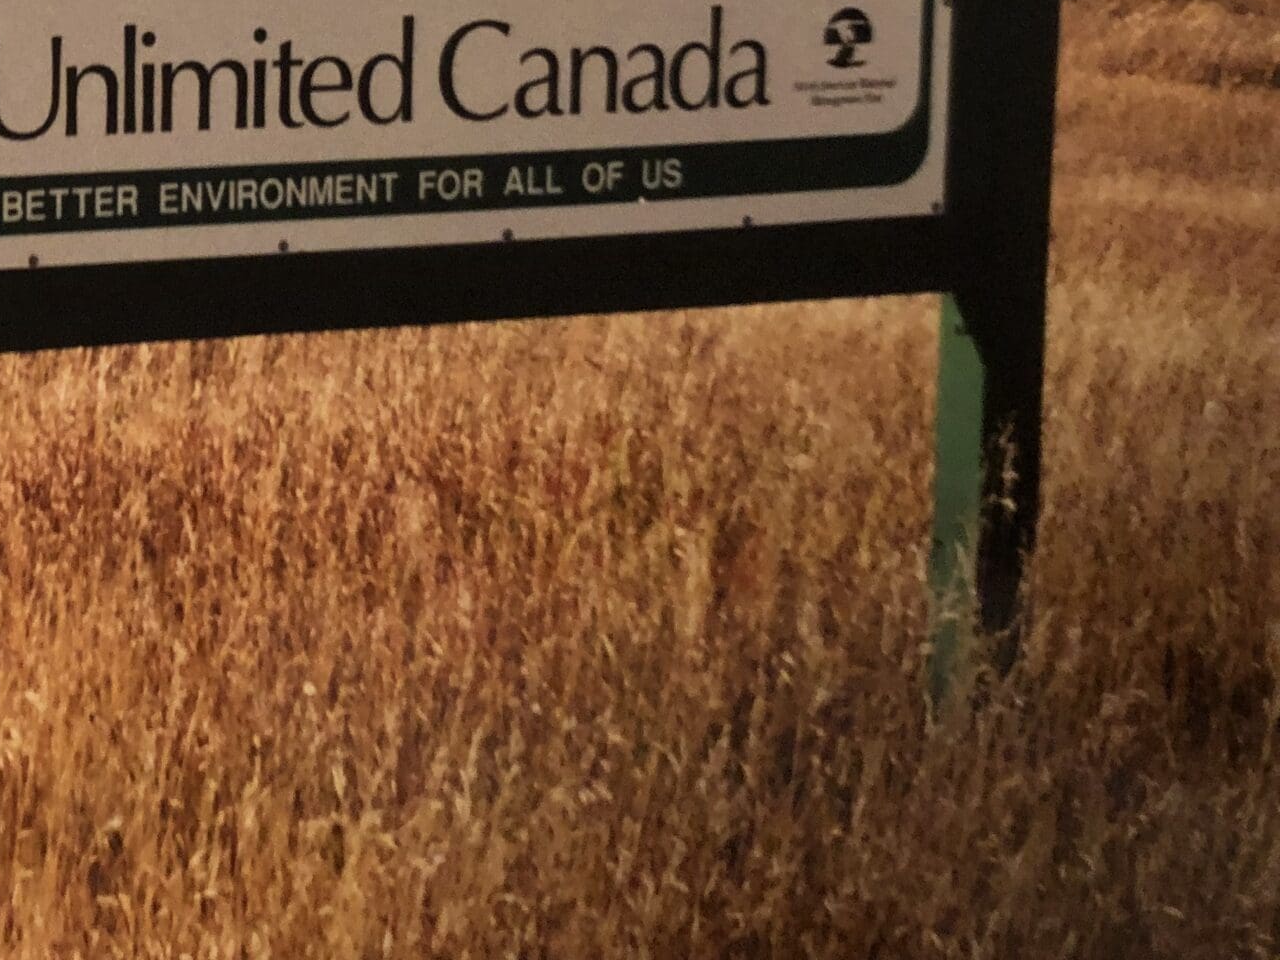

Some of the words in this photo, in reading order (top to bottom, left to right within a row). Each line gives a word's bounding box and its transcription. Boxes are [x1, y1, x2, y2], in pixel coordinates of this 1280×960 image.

[437, 4, 771, 122] Canada
[1, 184, 139, 223] BETTER
[159, 170, 399, 215] ENVIRONMENT
[419, 166, 484, 201] FOR
[502, 164, 564, 196] ALL
[581, 160, 624, 193] OF
[641, 157, 684, 190] US
